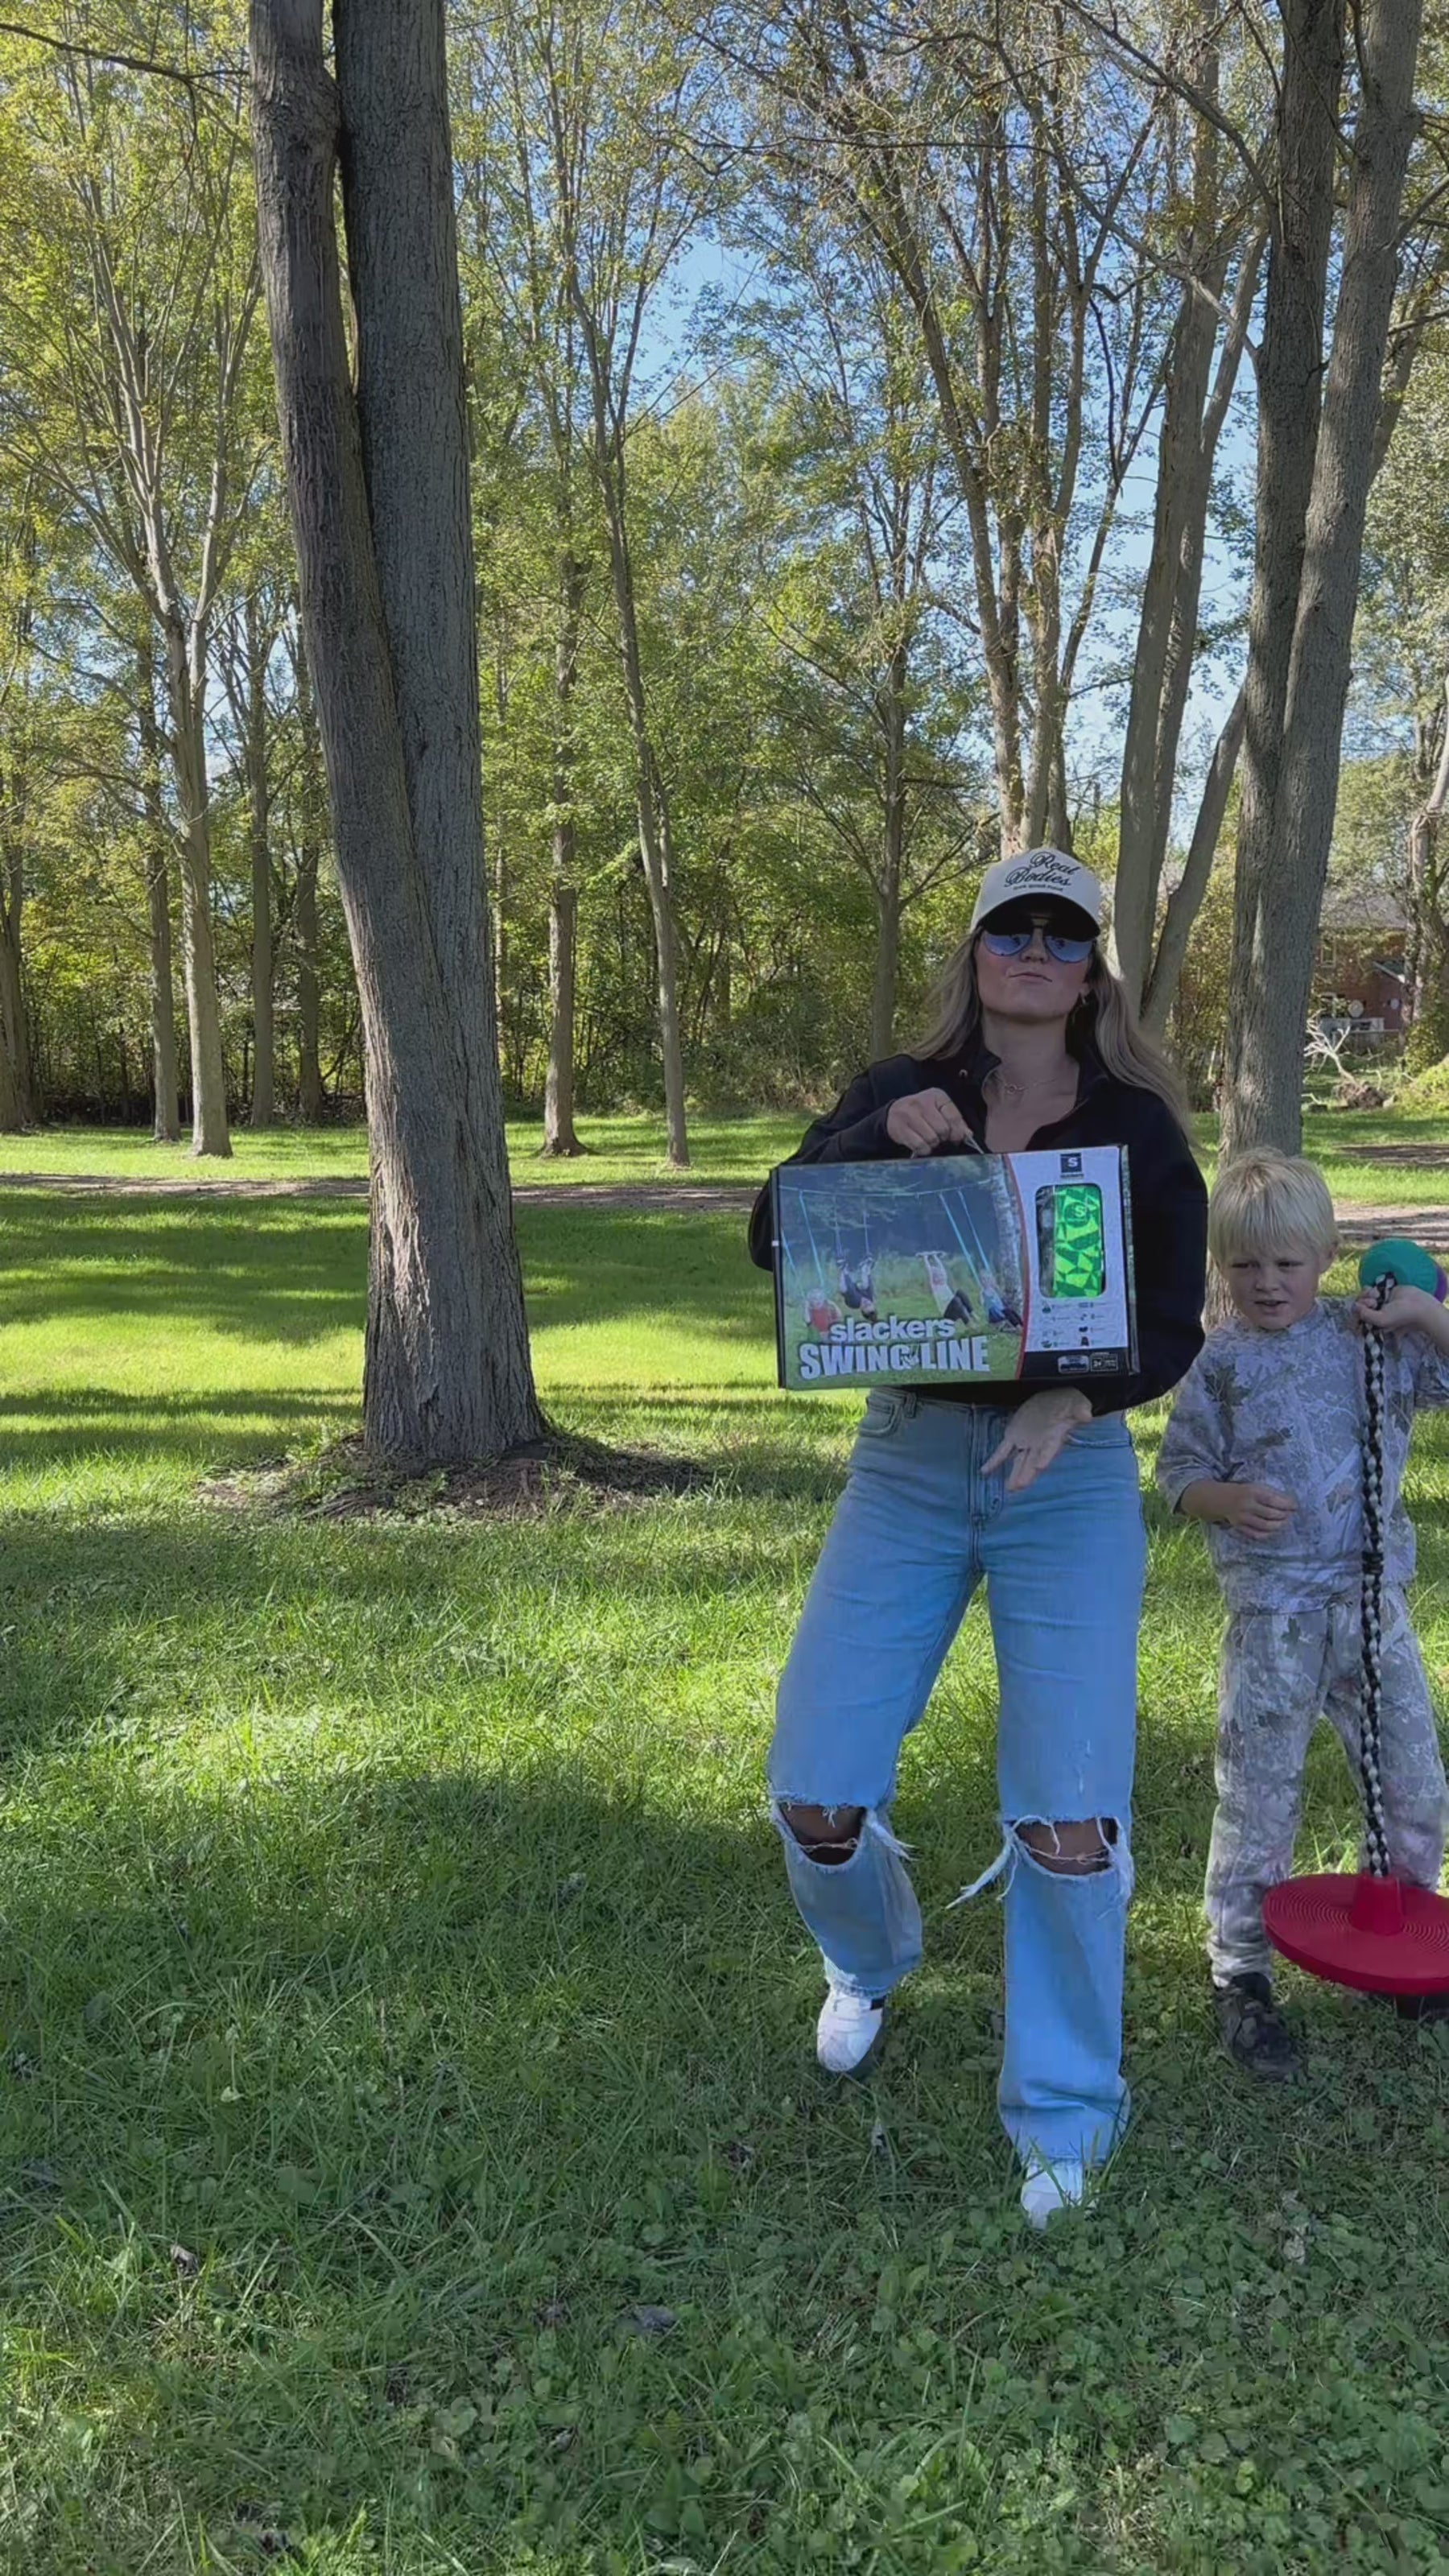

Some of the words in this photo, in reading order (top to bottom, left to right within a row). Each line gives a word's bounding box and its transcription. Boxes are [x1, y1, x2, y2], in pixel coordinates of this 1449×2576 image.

[1030, 851, 1081, 875] Real
[1004, 866, 1071, 887] Bodies
[830, 1315, 956, 1342] slackers
